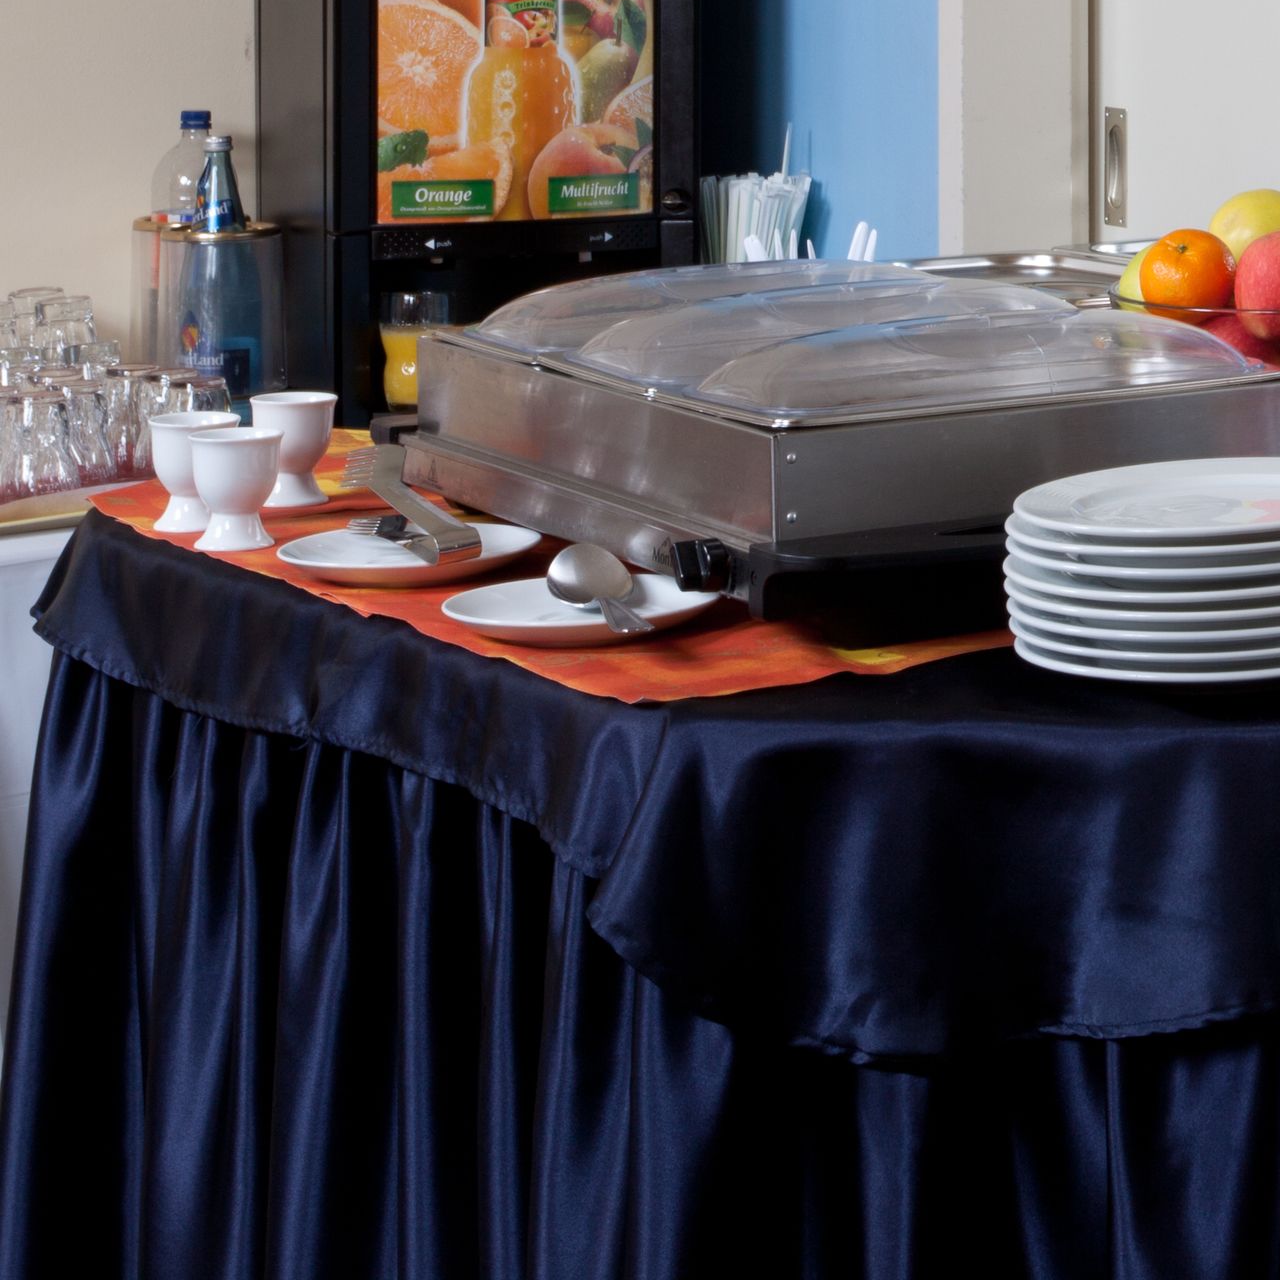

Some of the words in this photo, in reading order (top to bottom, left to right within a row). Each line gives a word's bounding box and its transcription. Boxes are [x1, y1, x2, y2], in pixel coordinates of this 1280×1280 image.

[415, 187, 472, 205] Orange
[561, 180, 629, 199] Multifrucht
[436, 240, 452, 248] push
